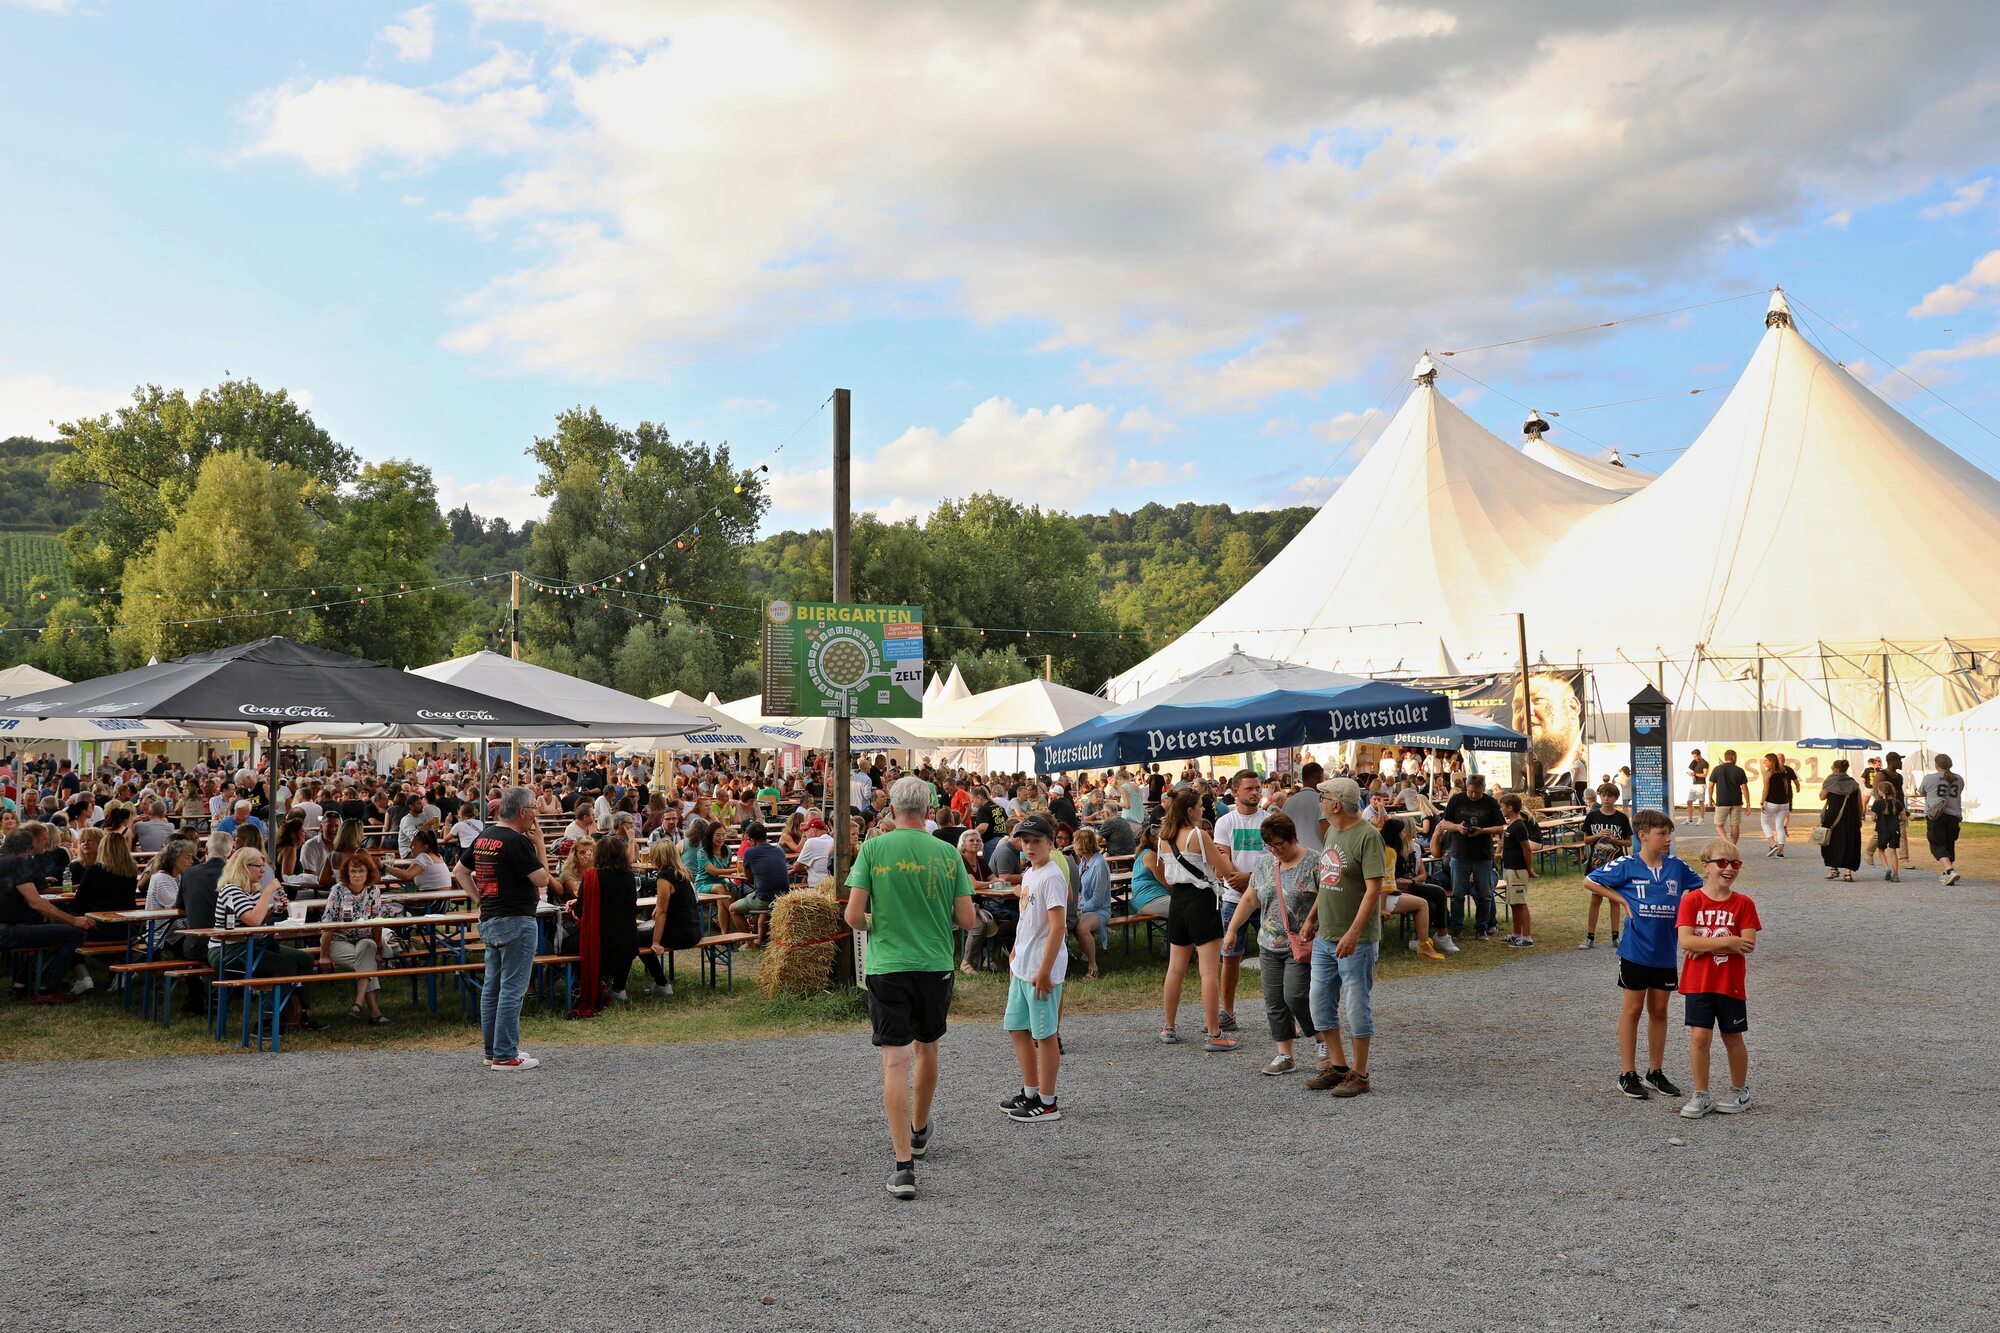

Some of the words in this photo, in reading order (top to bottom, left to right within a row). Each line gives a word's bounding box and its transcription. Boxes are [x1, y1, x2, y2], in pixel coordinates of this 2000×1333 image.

[797, 605, 911, 623] BIERGARTEN
[895, 670, 922, 681] ZELT
[238, 703, 333, 717] Coca-Cola
[416, 709, 497, 720] Coca-Cola
[1329, 703, 1429, 738] Peterstaler
[684, 733, 748, 744] HEUBACHER
[1147, 721, 1277, 758] Peterstaler
[1393, 733, 1450, 745] Peterstaler
[1473, 736, 1518, 749] Peterstaler
[1044, 740, 1103, 771] Peterstaler
[1744, 756, 1825, 783] SR1
[1937, 784, 1959, 798] 63
[1590, 823, 1622, 834] ROLLIN
[1635, 885, 1646, 899] 11
